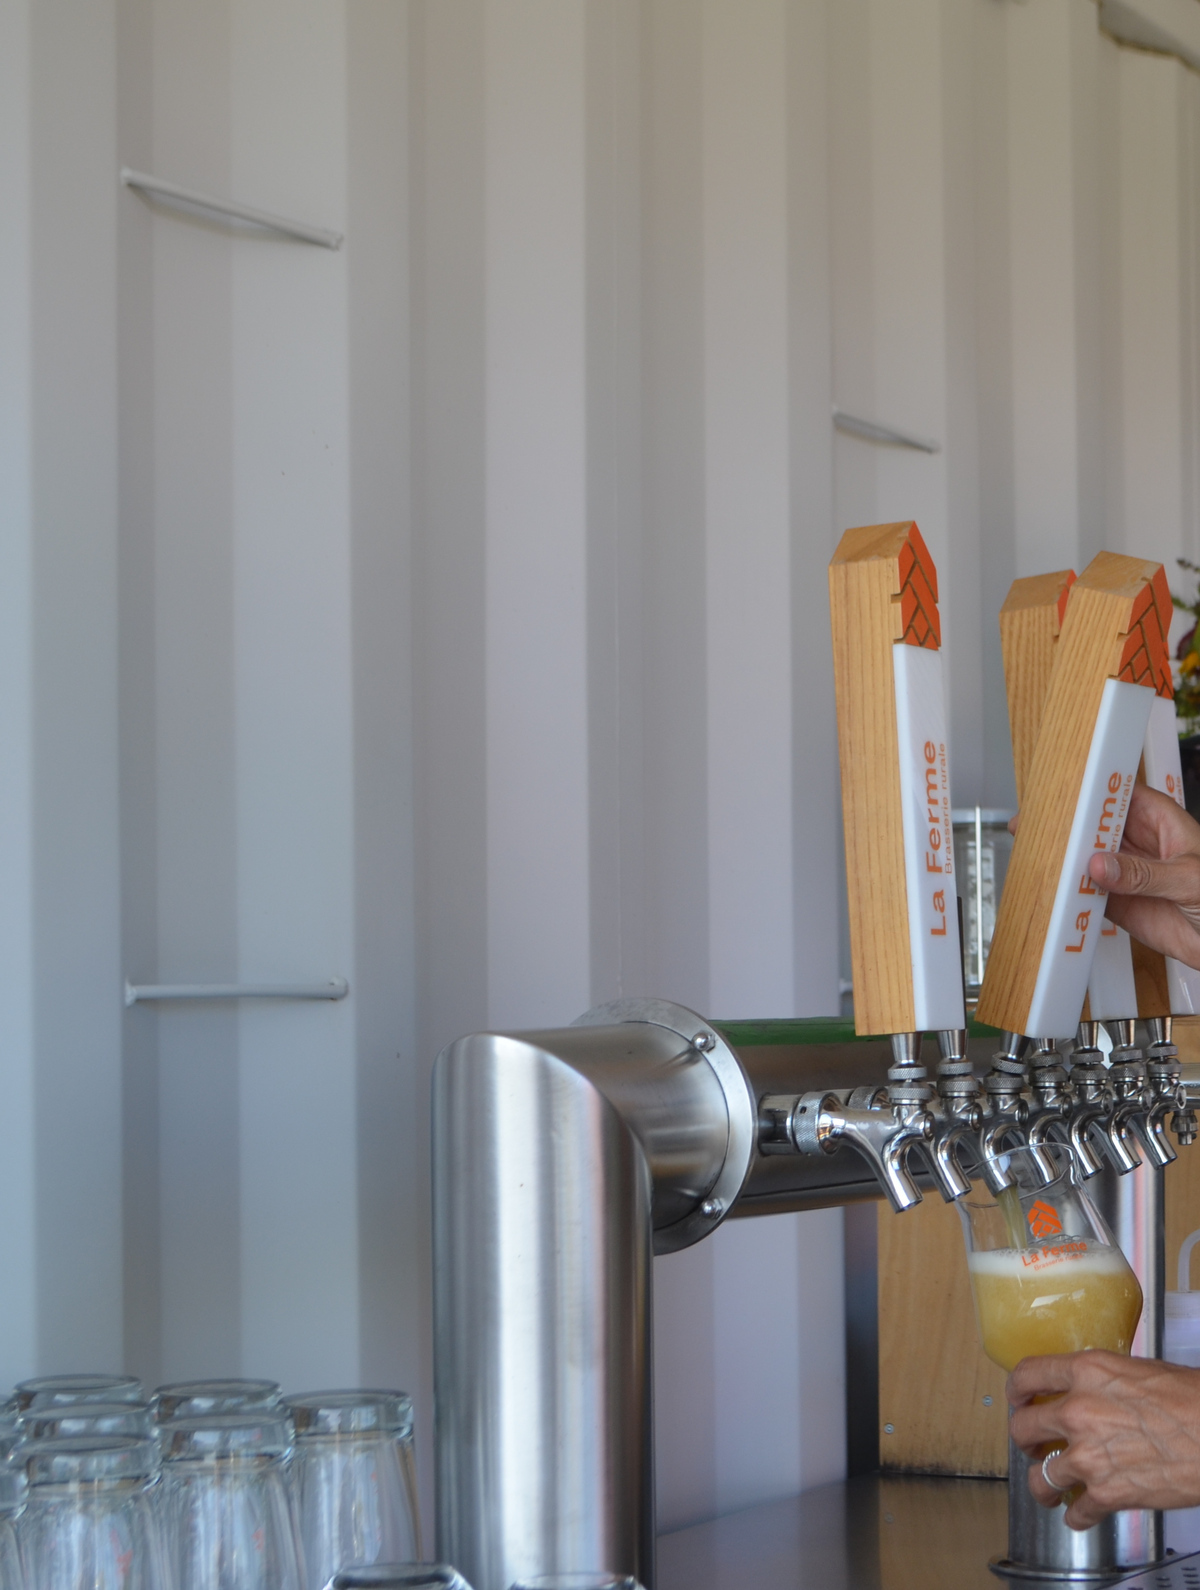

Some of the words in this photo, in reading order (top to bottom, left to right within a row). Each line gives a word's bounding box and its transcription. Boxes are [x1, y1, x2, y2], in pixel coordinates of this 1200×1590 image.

[938, 743, 947, 790] rurale
[923, 740, 943, 873] Ferme
[1118, 774, 1133, 818] rurale
[941, 796, 953, 874] Brasserie
[1078, 771, 1122, 895] Frme
[930, 889, 947, 936] La
[1065, 909, 1092, 953] La
[1021, 1253, 1040, 1267] La
[1041, 1241, 1088, 1259] Ferme
